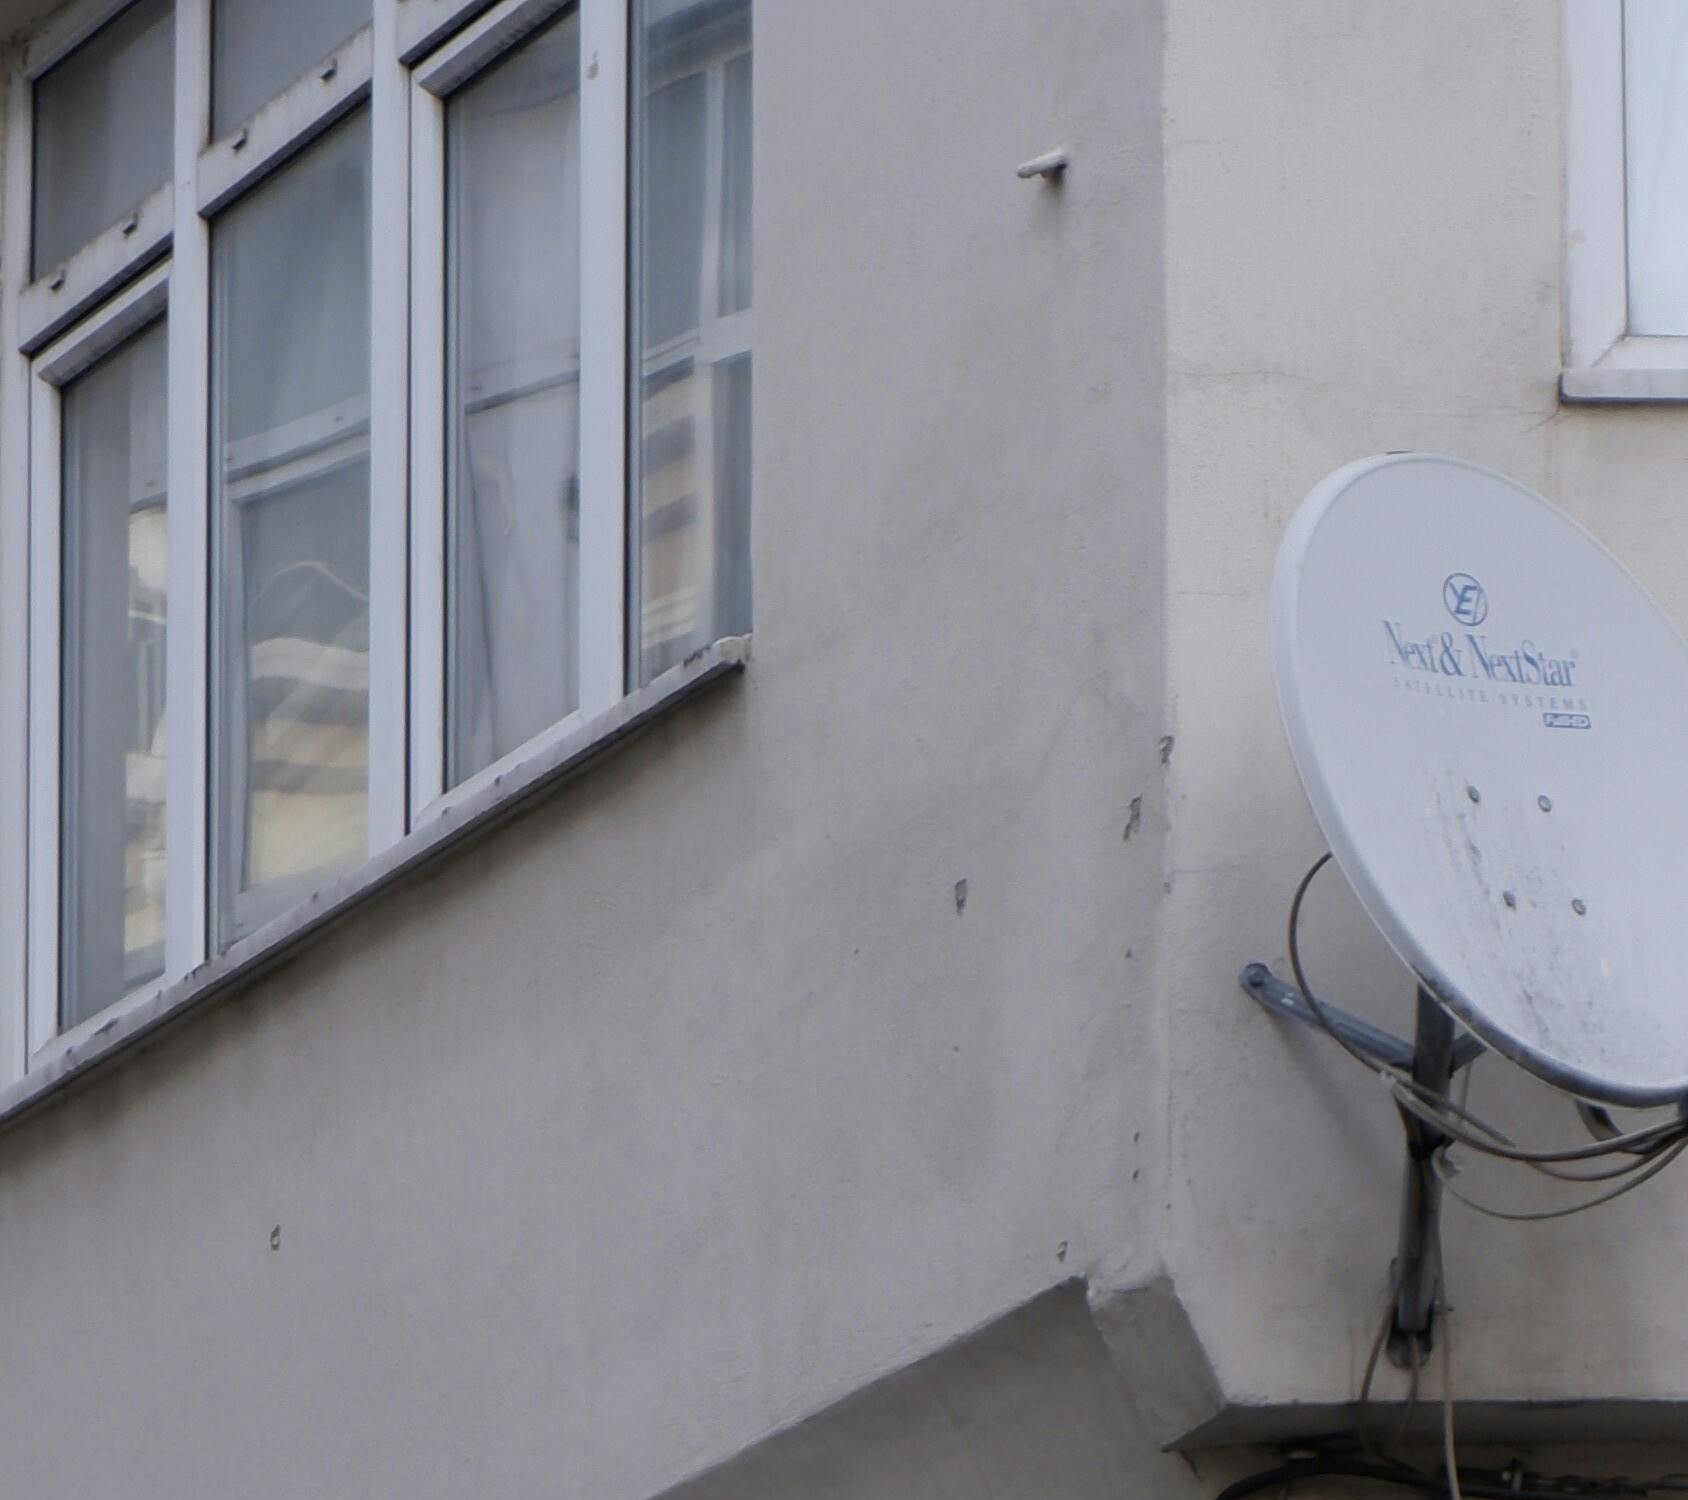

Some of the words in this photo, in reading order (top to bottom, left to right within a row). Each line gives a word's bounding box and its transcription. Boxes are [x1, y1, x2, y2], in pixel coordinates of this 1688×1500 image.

[1440, 632, 1465, 676] &
[1465, 634, 1576, 686] NextStar
[1500, 694, 1587, 711] SYSTEMS
